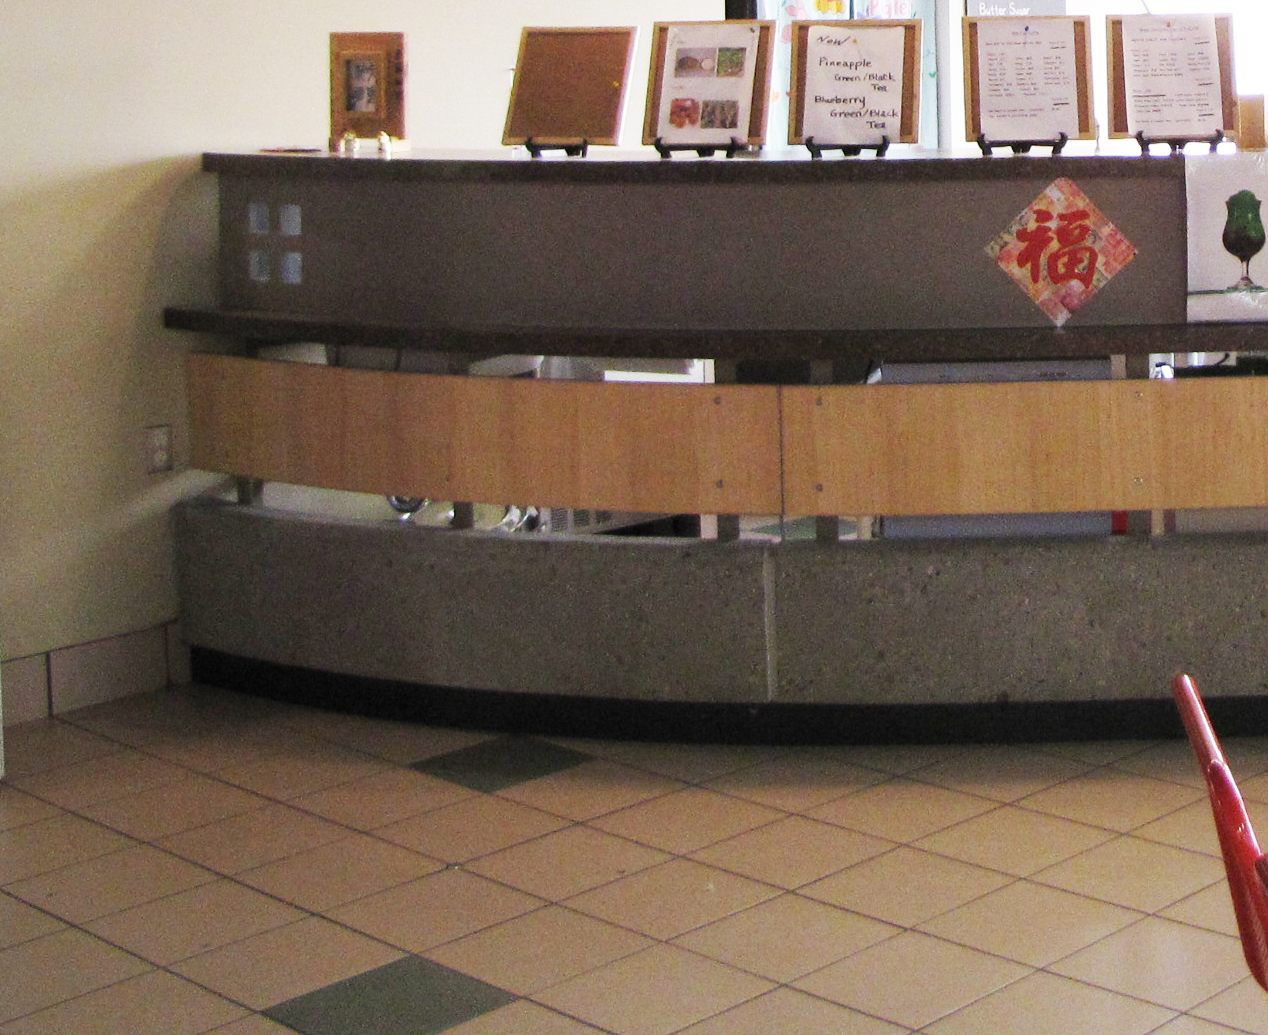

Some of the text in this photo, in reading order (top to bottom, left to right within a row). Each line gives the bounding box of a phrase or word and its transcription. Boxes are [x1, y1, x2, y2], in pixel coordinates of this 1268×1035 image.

[979, 2, 1007, 16] Butter
[819, 56, 872, 71] Pineapple
[871, 83, 887, 92] Tea
[814, 95, 866, 110] Blueberry
[866, 120, 885, 129] Tea
[1015, 207, 1100, 289] 福
